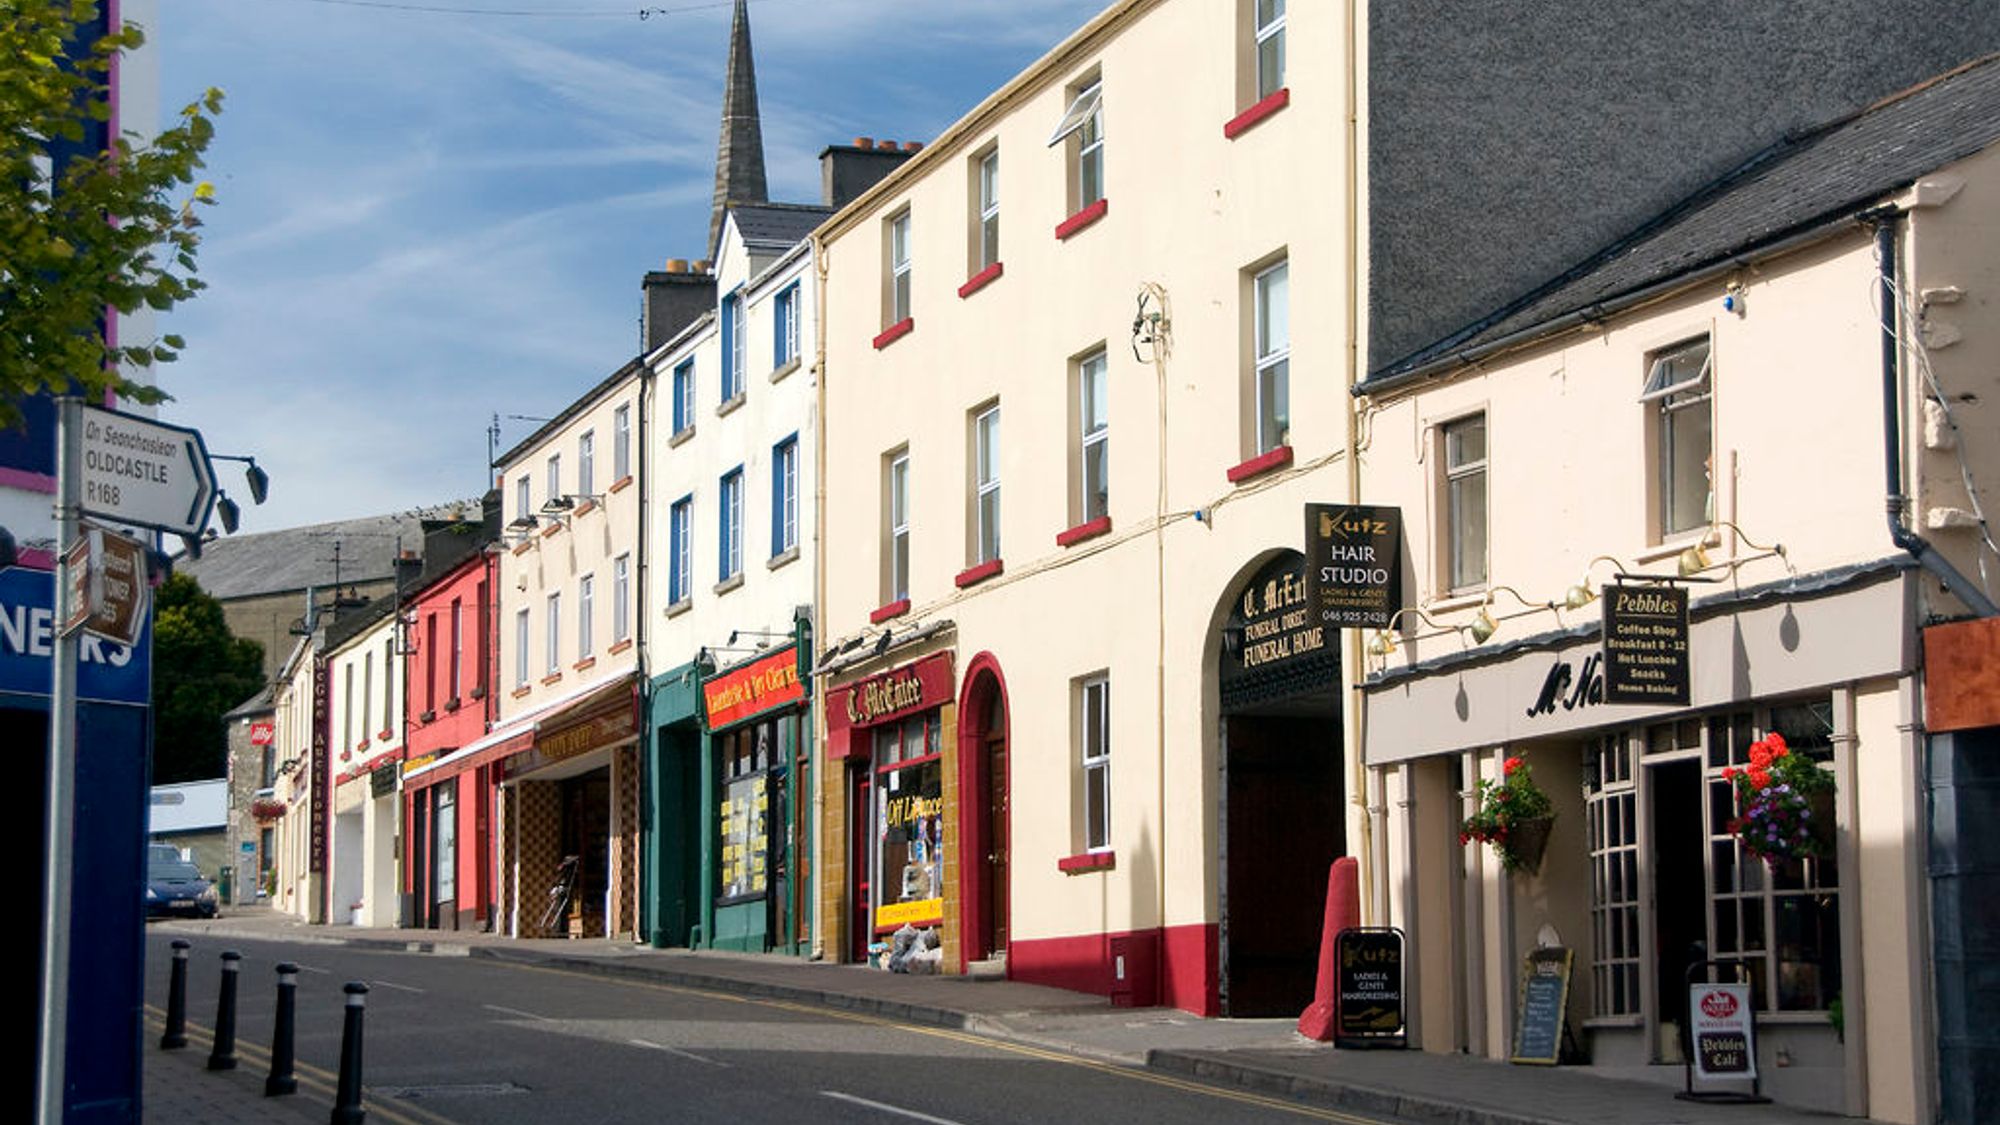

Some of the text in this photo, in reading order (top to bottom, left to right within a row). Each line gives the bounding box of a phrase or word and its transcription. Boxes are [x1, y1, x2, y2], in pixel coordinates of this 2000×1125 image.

[86, 450, 168, 484] OLDCASTLE
[1319, 510, 1392, 539] Kutz
[1331, 545, 1376, 562] HAIR
[1320, 567, 1388, 584] STUDIO
[1615, 593, 1678, 613] Pebbles
[1322, 610, 1388, 623] 046 925 2428
[1245, 618, 1280, 642] FUNERAL
[1617, 624, 1677, 637] Coffee Shop
[1244, 627, 1324, 668] FUNERAL HOME
[1607, 639, 1656, 649] Breakfast
[1674, 641, 1686, 650] 12
[1617, 653, 1677, 665] Hot Lunches
[1630, 668, 1665, 680] Snacks
[1617, 684, 1678, 695] Home Baking
[1702, 1038, 1745, 1053] Pebbles
